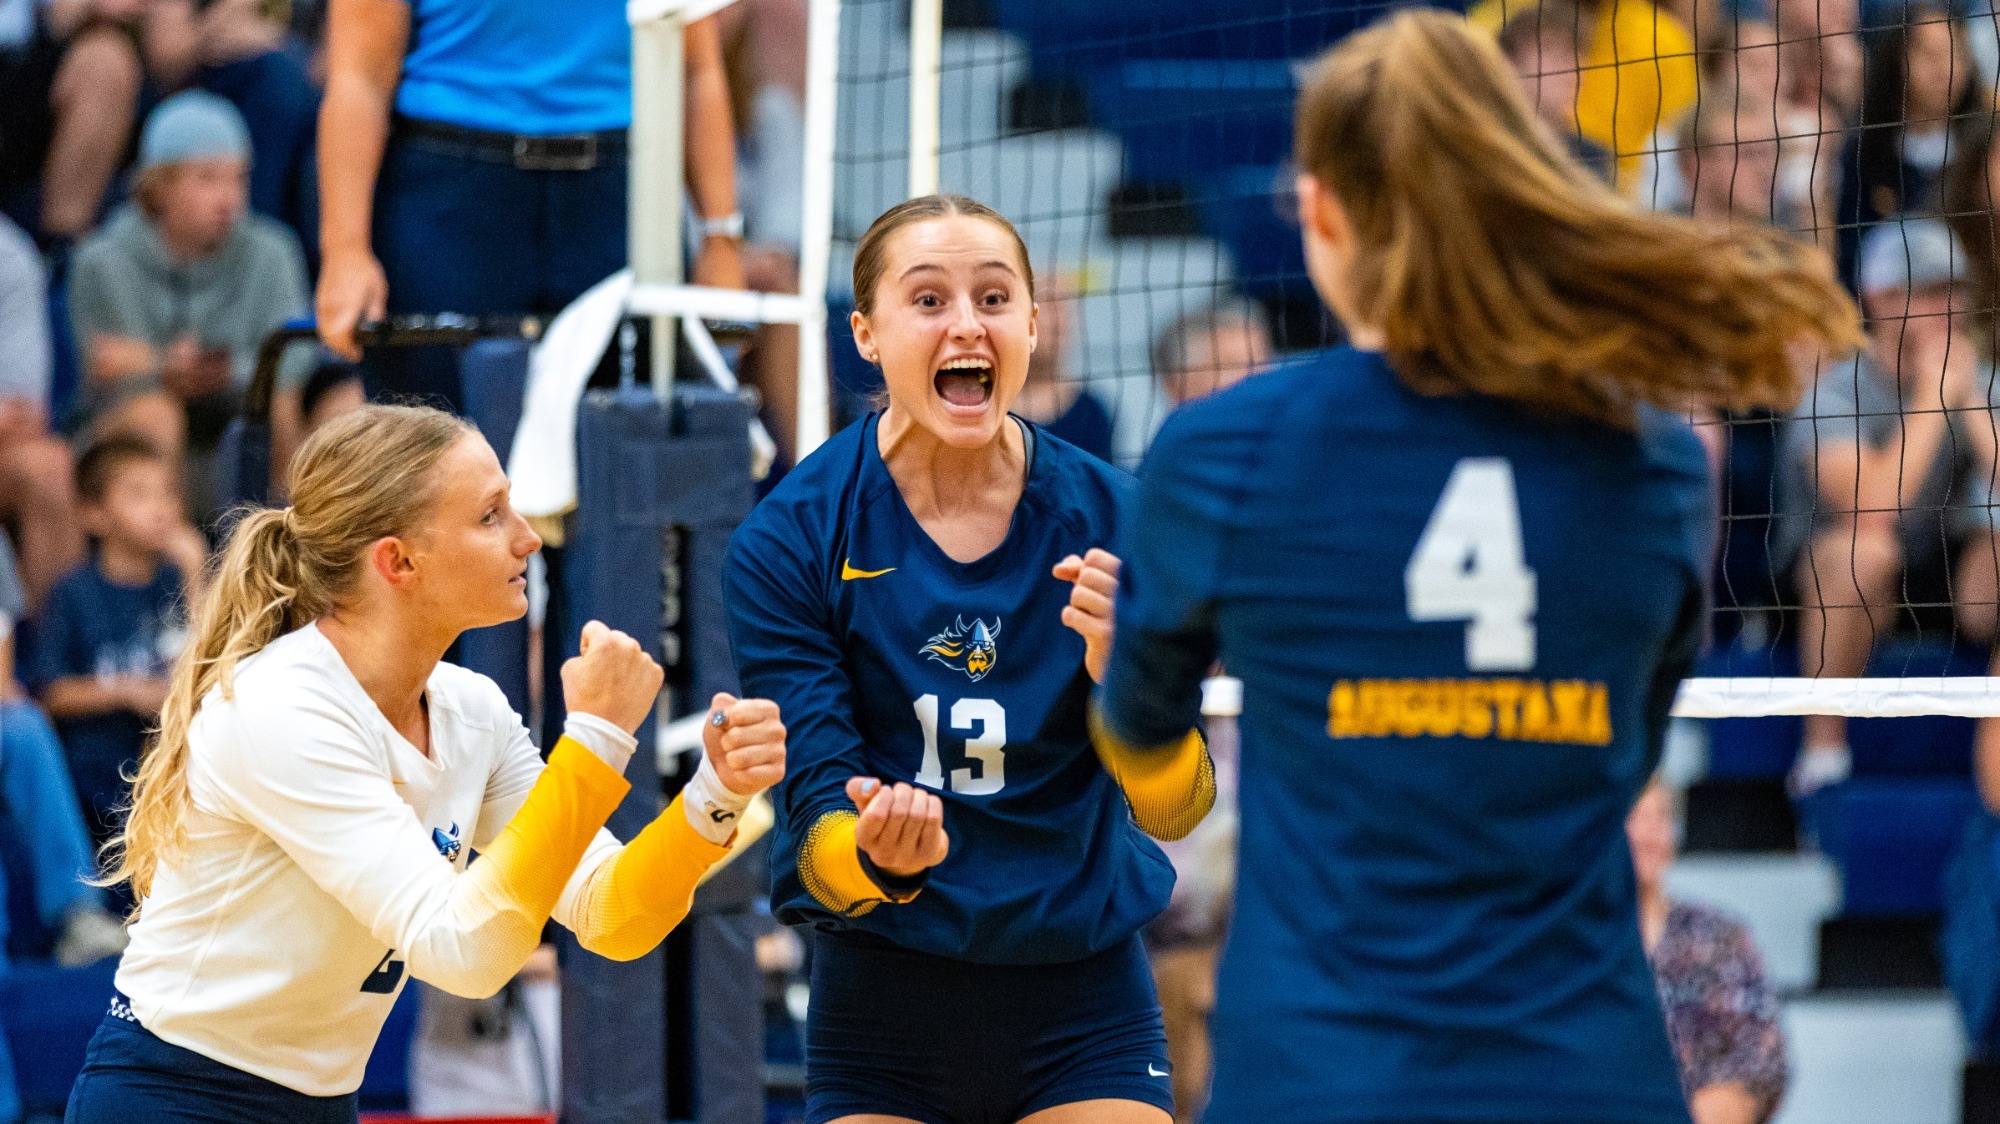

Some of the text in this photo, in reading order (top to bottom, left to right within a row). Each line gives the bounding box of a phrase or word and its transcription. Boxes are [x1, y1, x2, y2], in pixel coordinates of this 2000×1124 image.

[1405, 457, 1537, 671] 4
[914, 694, 1006, 795] 13
[1327, 679, 1612, 744] AUGUSTANA
